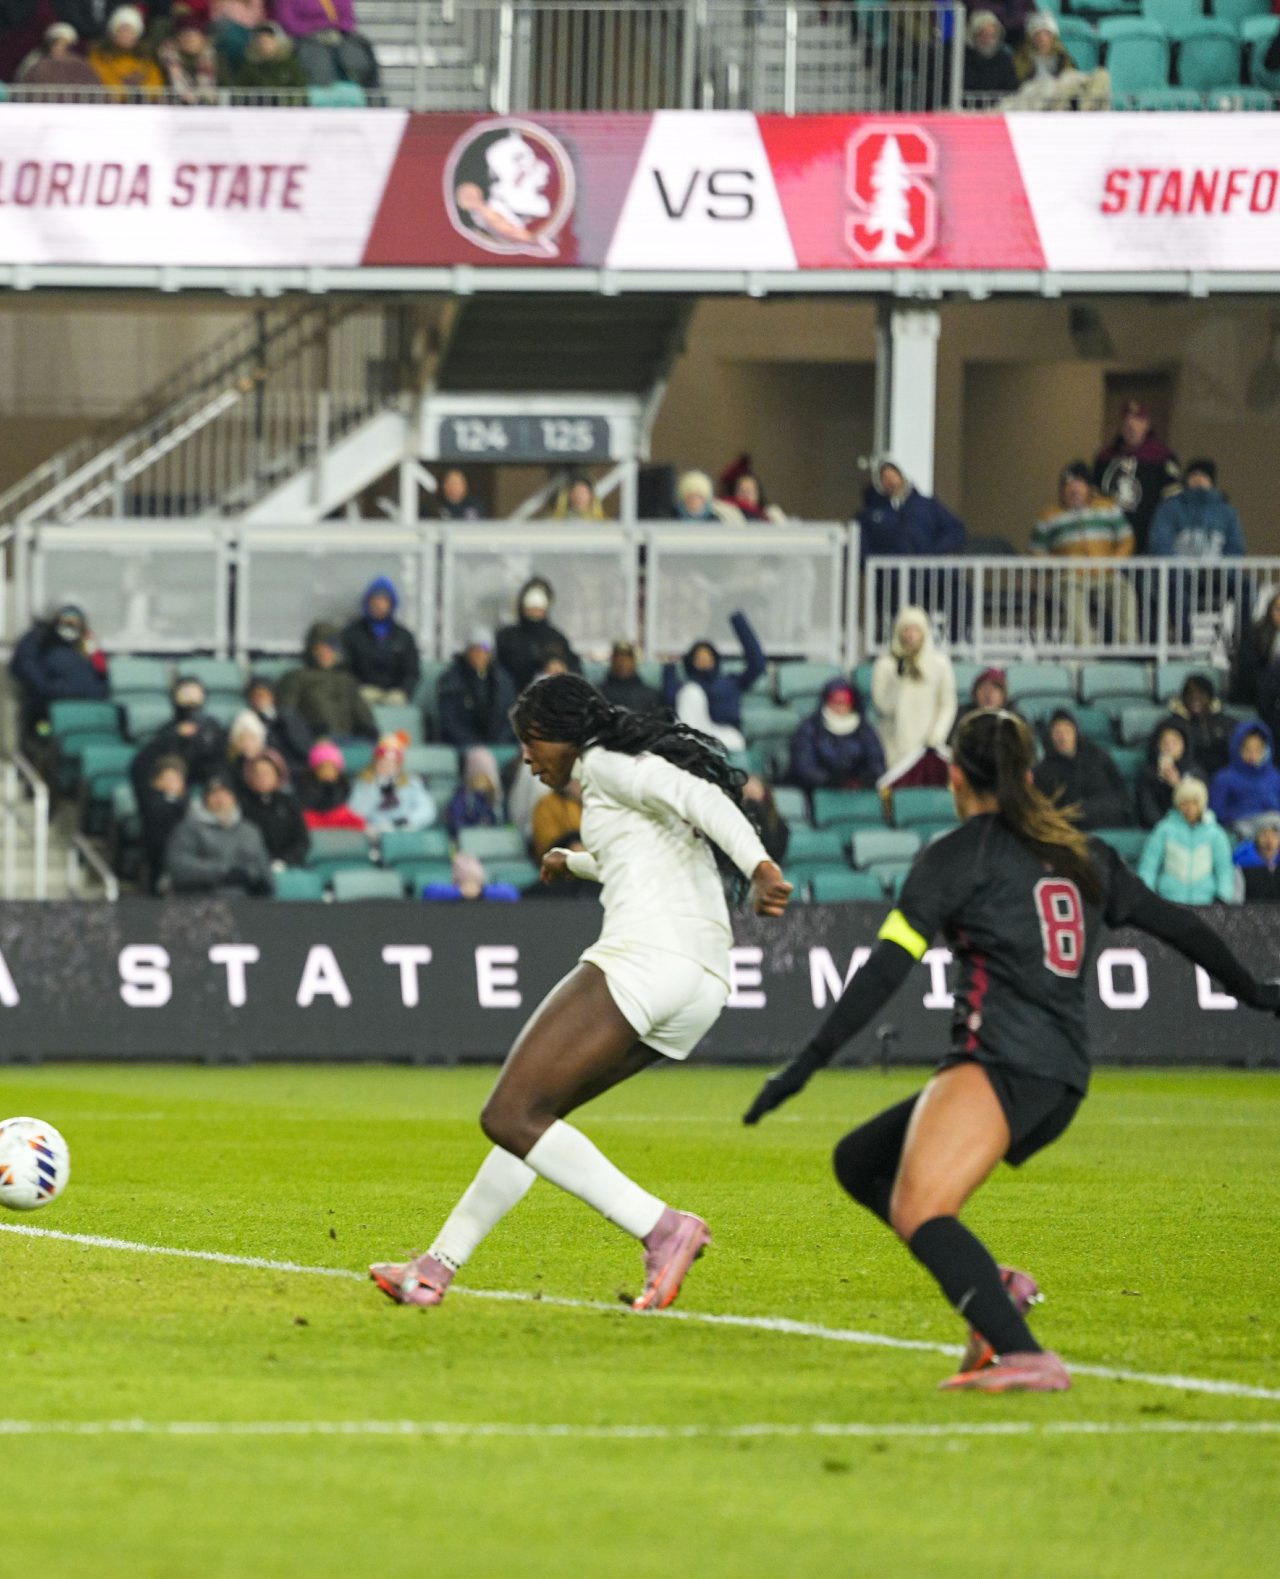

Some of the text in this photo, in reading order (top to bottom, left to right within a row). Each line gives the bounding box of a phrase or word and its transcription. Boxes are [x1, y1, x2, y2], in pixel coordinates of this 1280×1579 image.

[170, 163, 310, 211] STATE
[653, 168, 756, 221] VS
[1100, 167, 1279, 215] STANFO
[453, 418, 596, 452] 124 125
[1033, 877, 1085, 977] 8
[120, 945, 522, 1008] STATE
